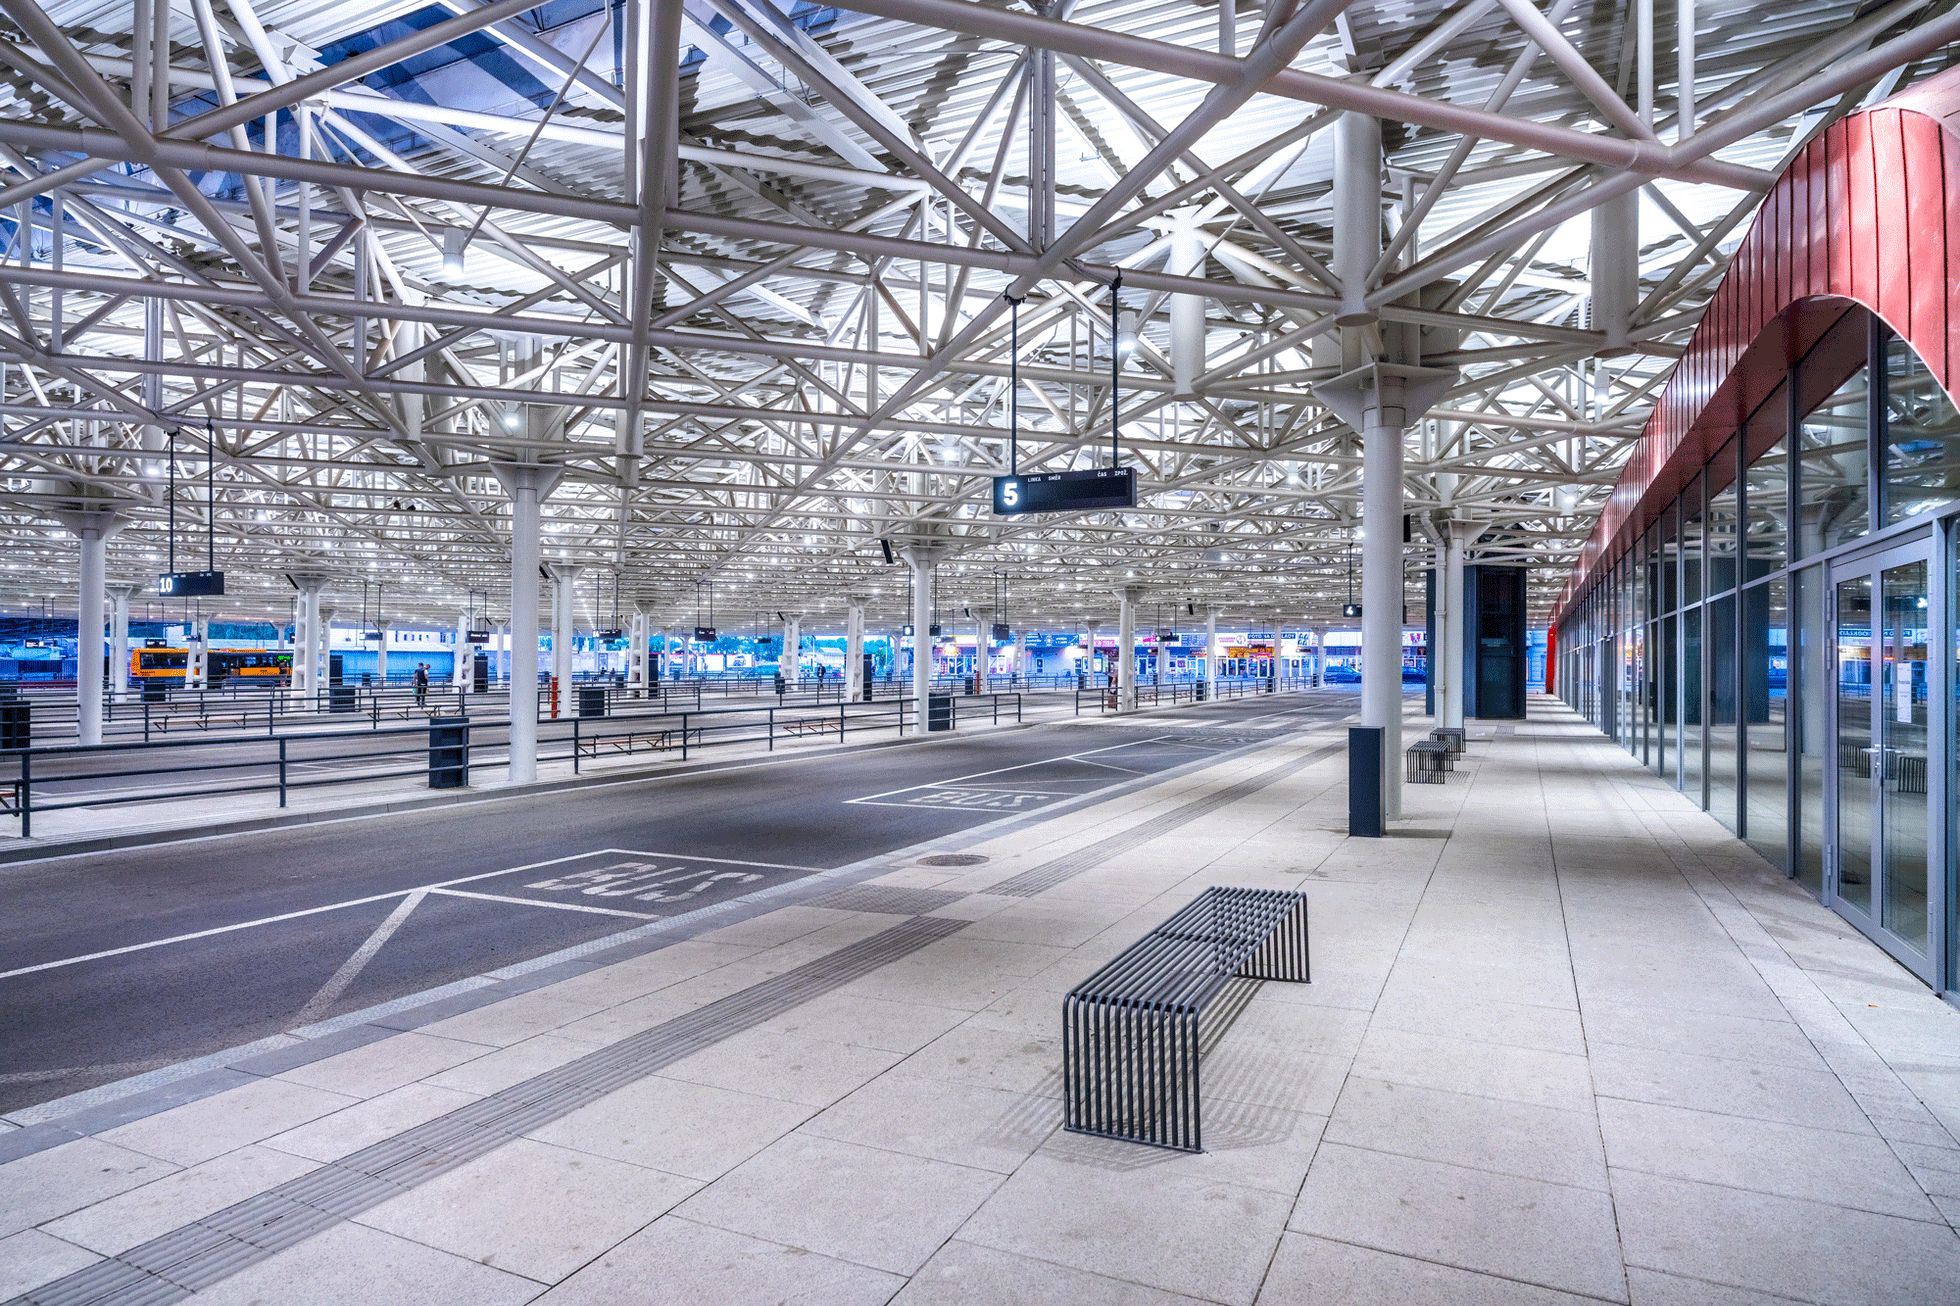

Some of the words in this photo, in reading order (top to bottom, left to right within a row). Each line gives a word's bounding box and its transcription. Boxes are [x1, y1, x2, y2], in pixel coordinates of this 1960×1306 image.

[1003, 482, 1018, 506] 5
[160, 578, 172, 592] 10
[1346, 606, 1354, 615] 4
[907, 791, 1049, 808] BUS
[523, 861, 766, 903] BUS
